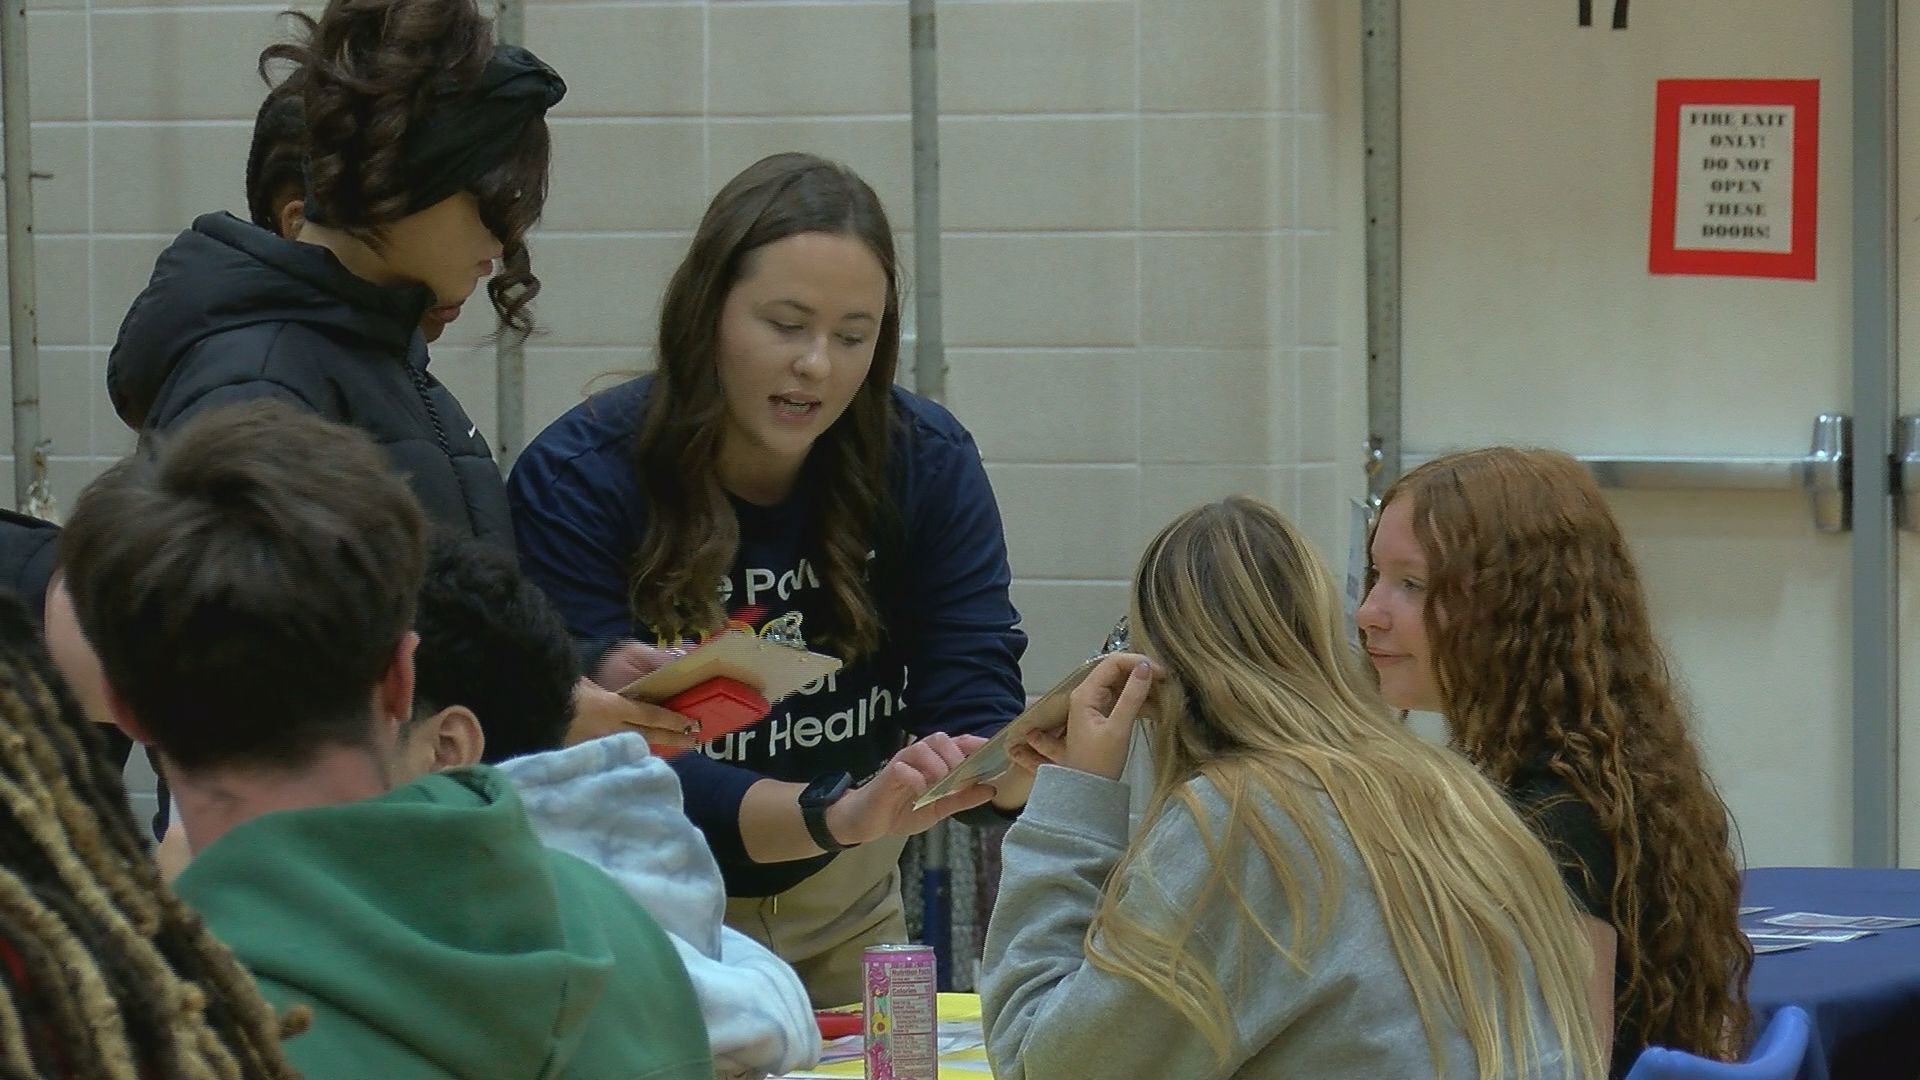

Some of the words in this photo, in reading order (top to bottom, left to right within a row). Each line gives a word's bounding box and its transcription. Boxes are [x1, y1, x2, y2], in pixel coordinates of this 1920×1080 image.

[1690, 112, 1735, 126] FIRE
[1742, 112, 1787, 127] EXIT
[1710, 135, 1766, 148] ONLY!
[1703, 158, 1729, 171] DO
[1736, 158, 1772, 171] NOT
[1710, 181, 1762, 193] OPEN
[1706, 203, 1766, 216] THESE
[1702, 225, 1770, 238] DOORS!
